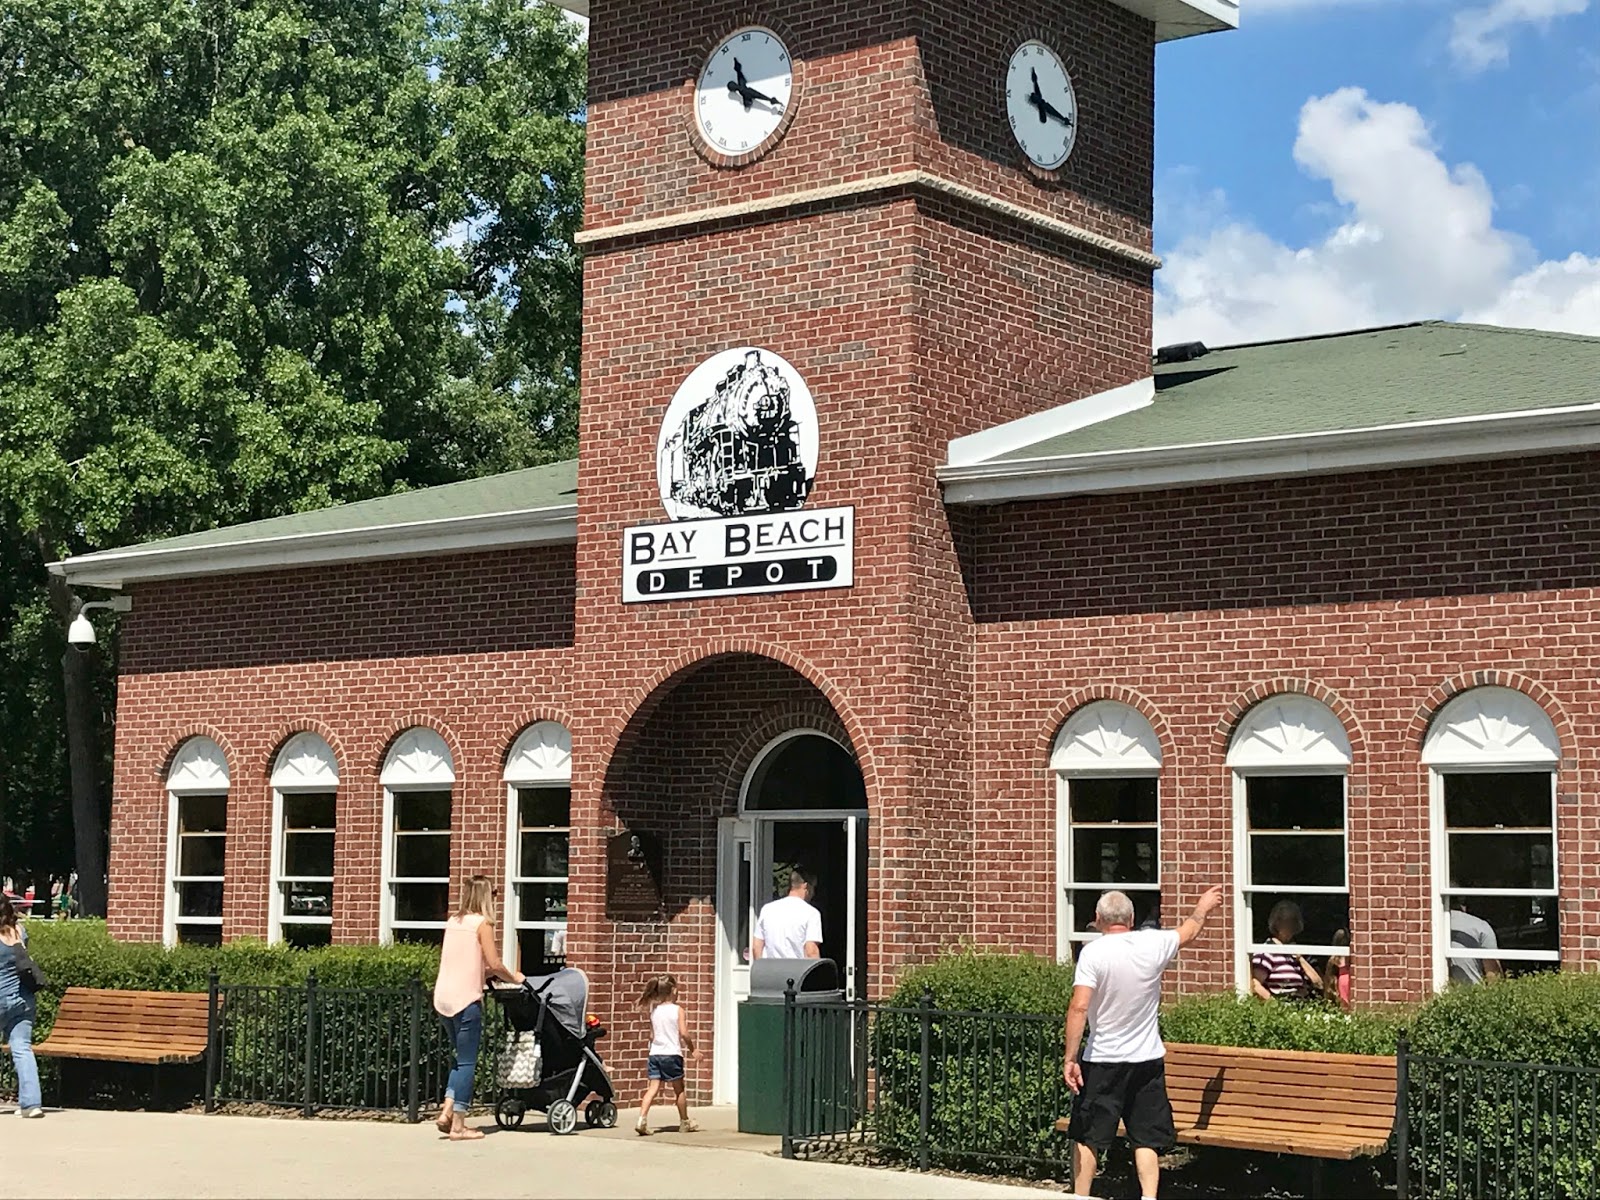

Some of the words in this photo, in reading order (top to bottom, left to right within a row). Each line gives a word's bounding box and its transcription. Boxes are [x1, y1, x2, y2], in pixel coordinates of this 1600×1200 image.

[742, 34, 751, 42] XII
[721, 45, 729, 55] XI
[630, 530, 697, 565] BAY
[724, 516, 844, 557] BEACH
[649, 559, 824, 592] DEPOT
